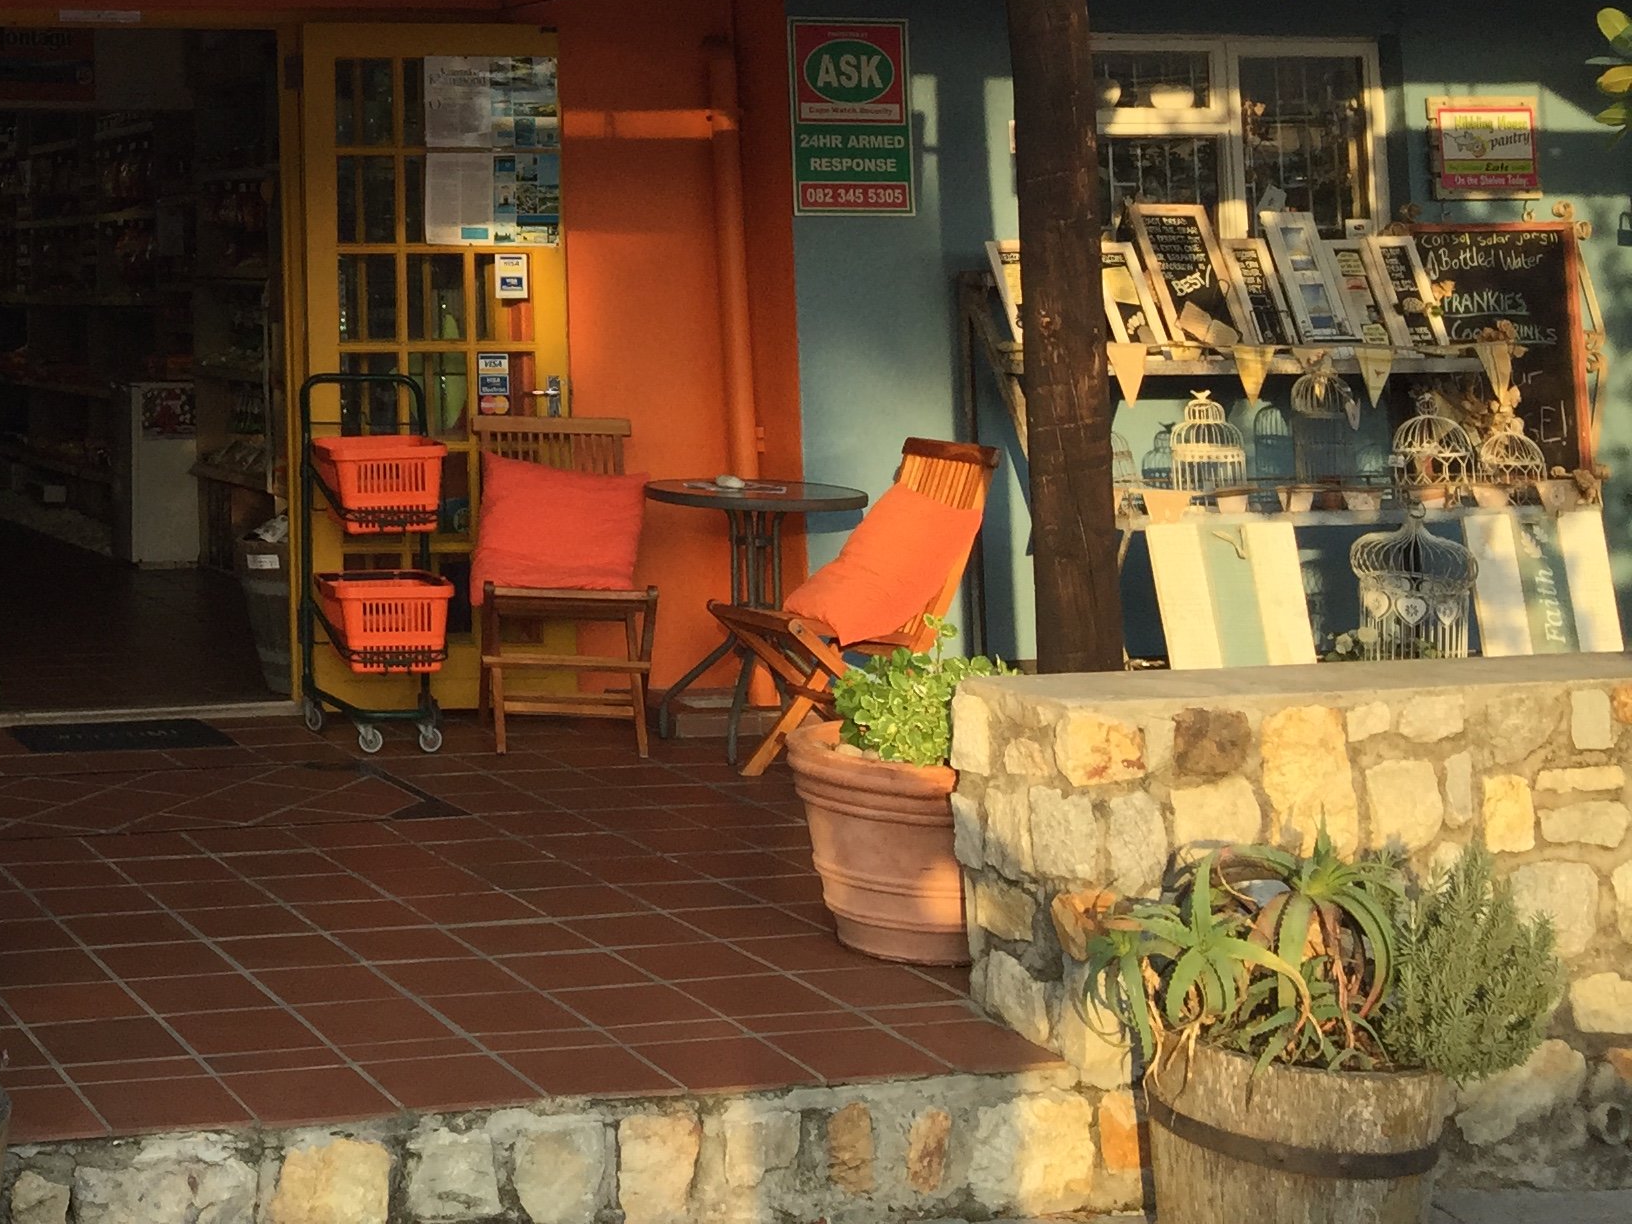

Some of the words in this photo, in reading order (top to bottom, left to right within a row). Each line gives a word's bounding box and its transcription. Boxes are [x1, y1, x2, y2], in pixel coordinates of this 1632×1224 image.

[817, 54, 884, 88] ASK
[800, 134, 843, 148] 24HR
[847, 135, 905, 149] ARMED
[1488, 131, 1531, 150] pantry
[810, 157, 897, 172] RESPONSE
[806, 188, 833, 203] 082
[837, 188, 864, 203] 345
[868, 188, 903, 203] 5305
[1477, 232, 1511, 247] solar
[1438, 246, 1495, 271] Bottled
[1499, 249, 1544, 271] Water
[1514, 323, 1559, 342] RINKS
[484, 360, 503, 368] VISA
[1535, 567, 1566, 644] Faith
